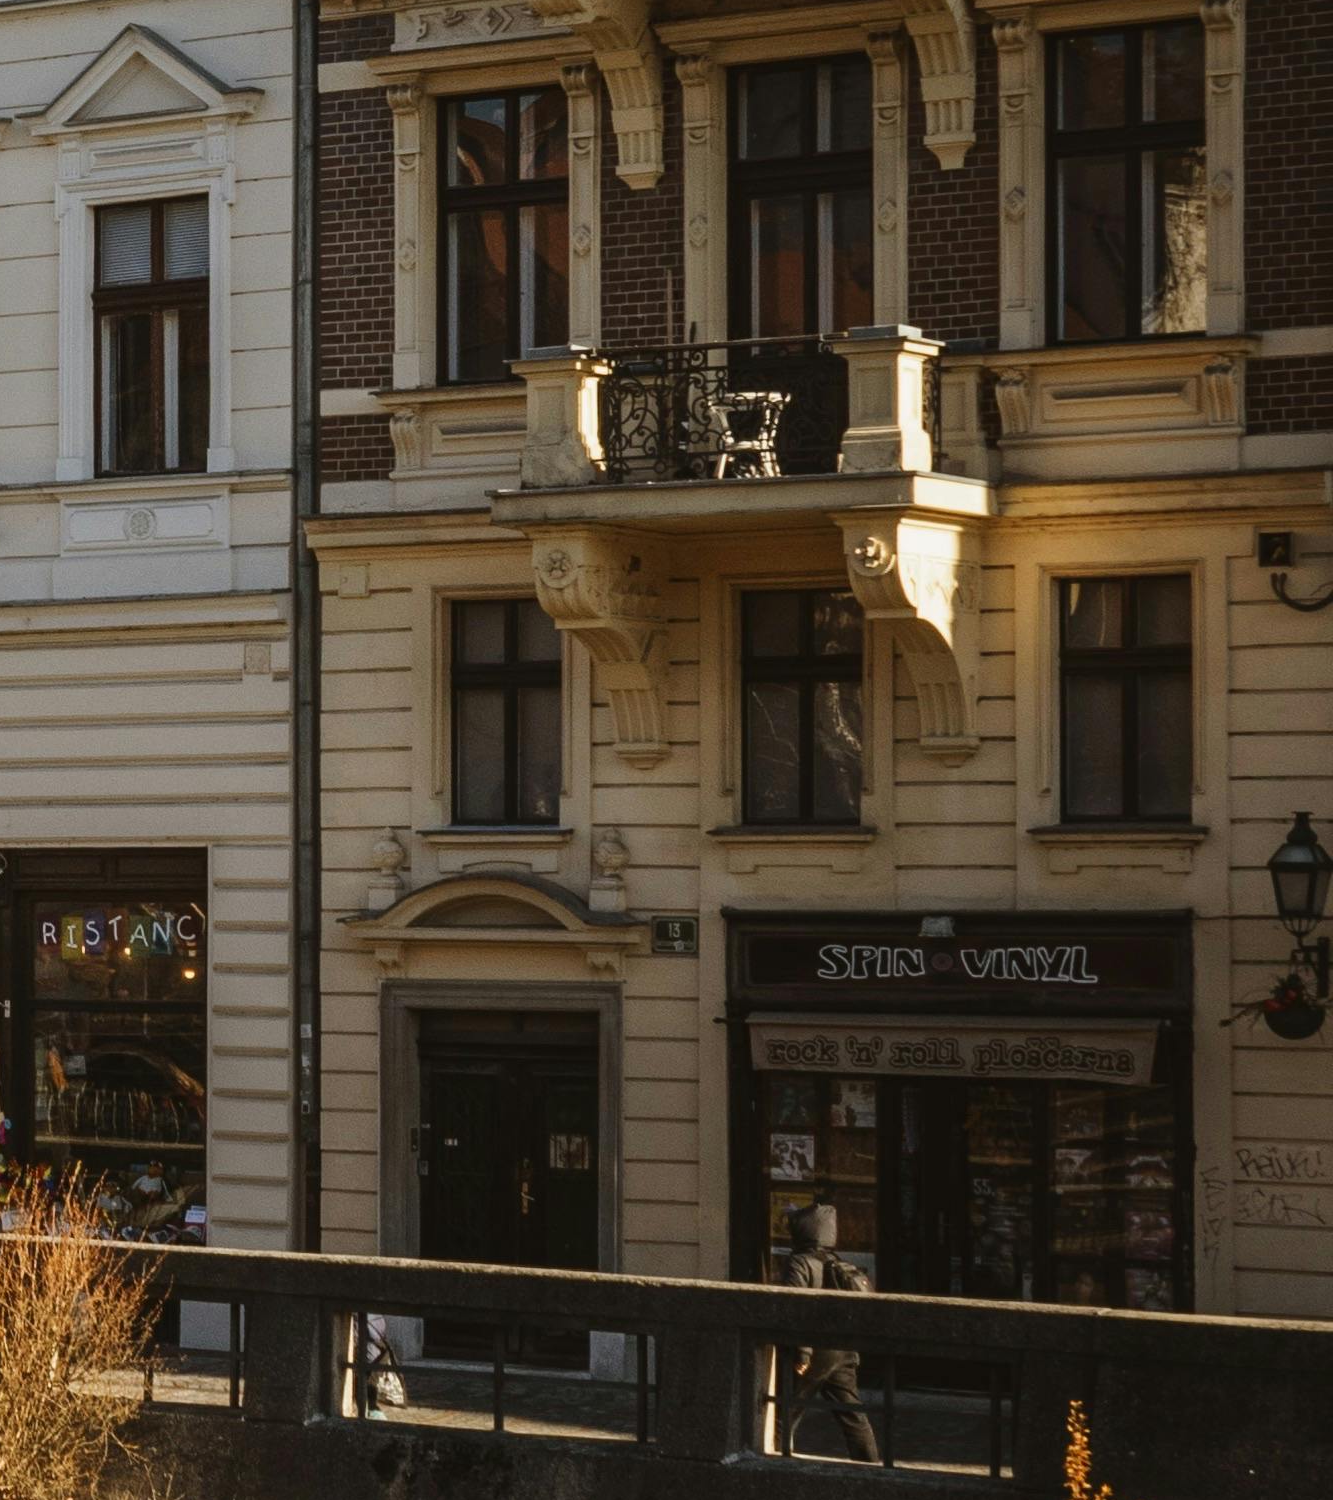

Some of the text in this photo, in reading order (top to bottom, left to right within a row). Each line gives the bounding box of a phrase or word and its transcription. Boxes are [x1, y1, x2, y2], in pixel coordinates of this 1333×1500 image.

[42, 915, 196, 949] RISTANC
[669, 922, 680, 938] 13
[817, 944, 1098, 983] SPIN VINYL
[767, 1036, 838, 1066] rock
[890, 1038, 965, 1069] roll
[972, 1038, 1135, 1076] ploščarna
